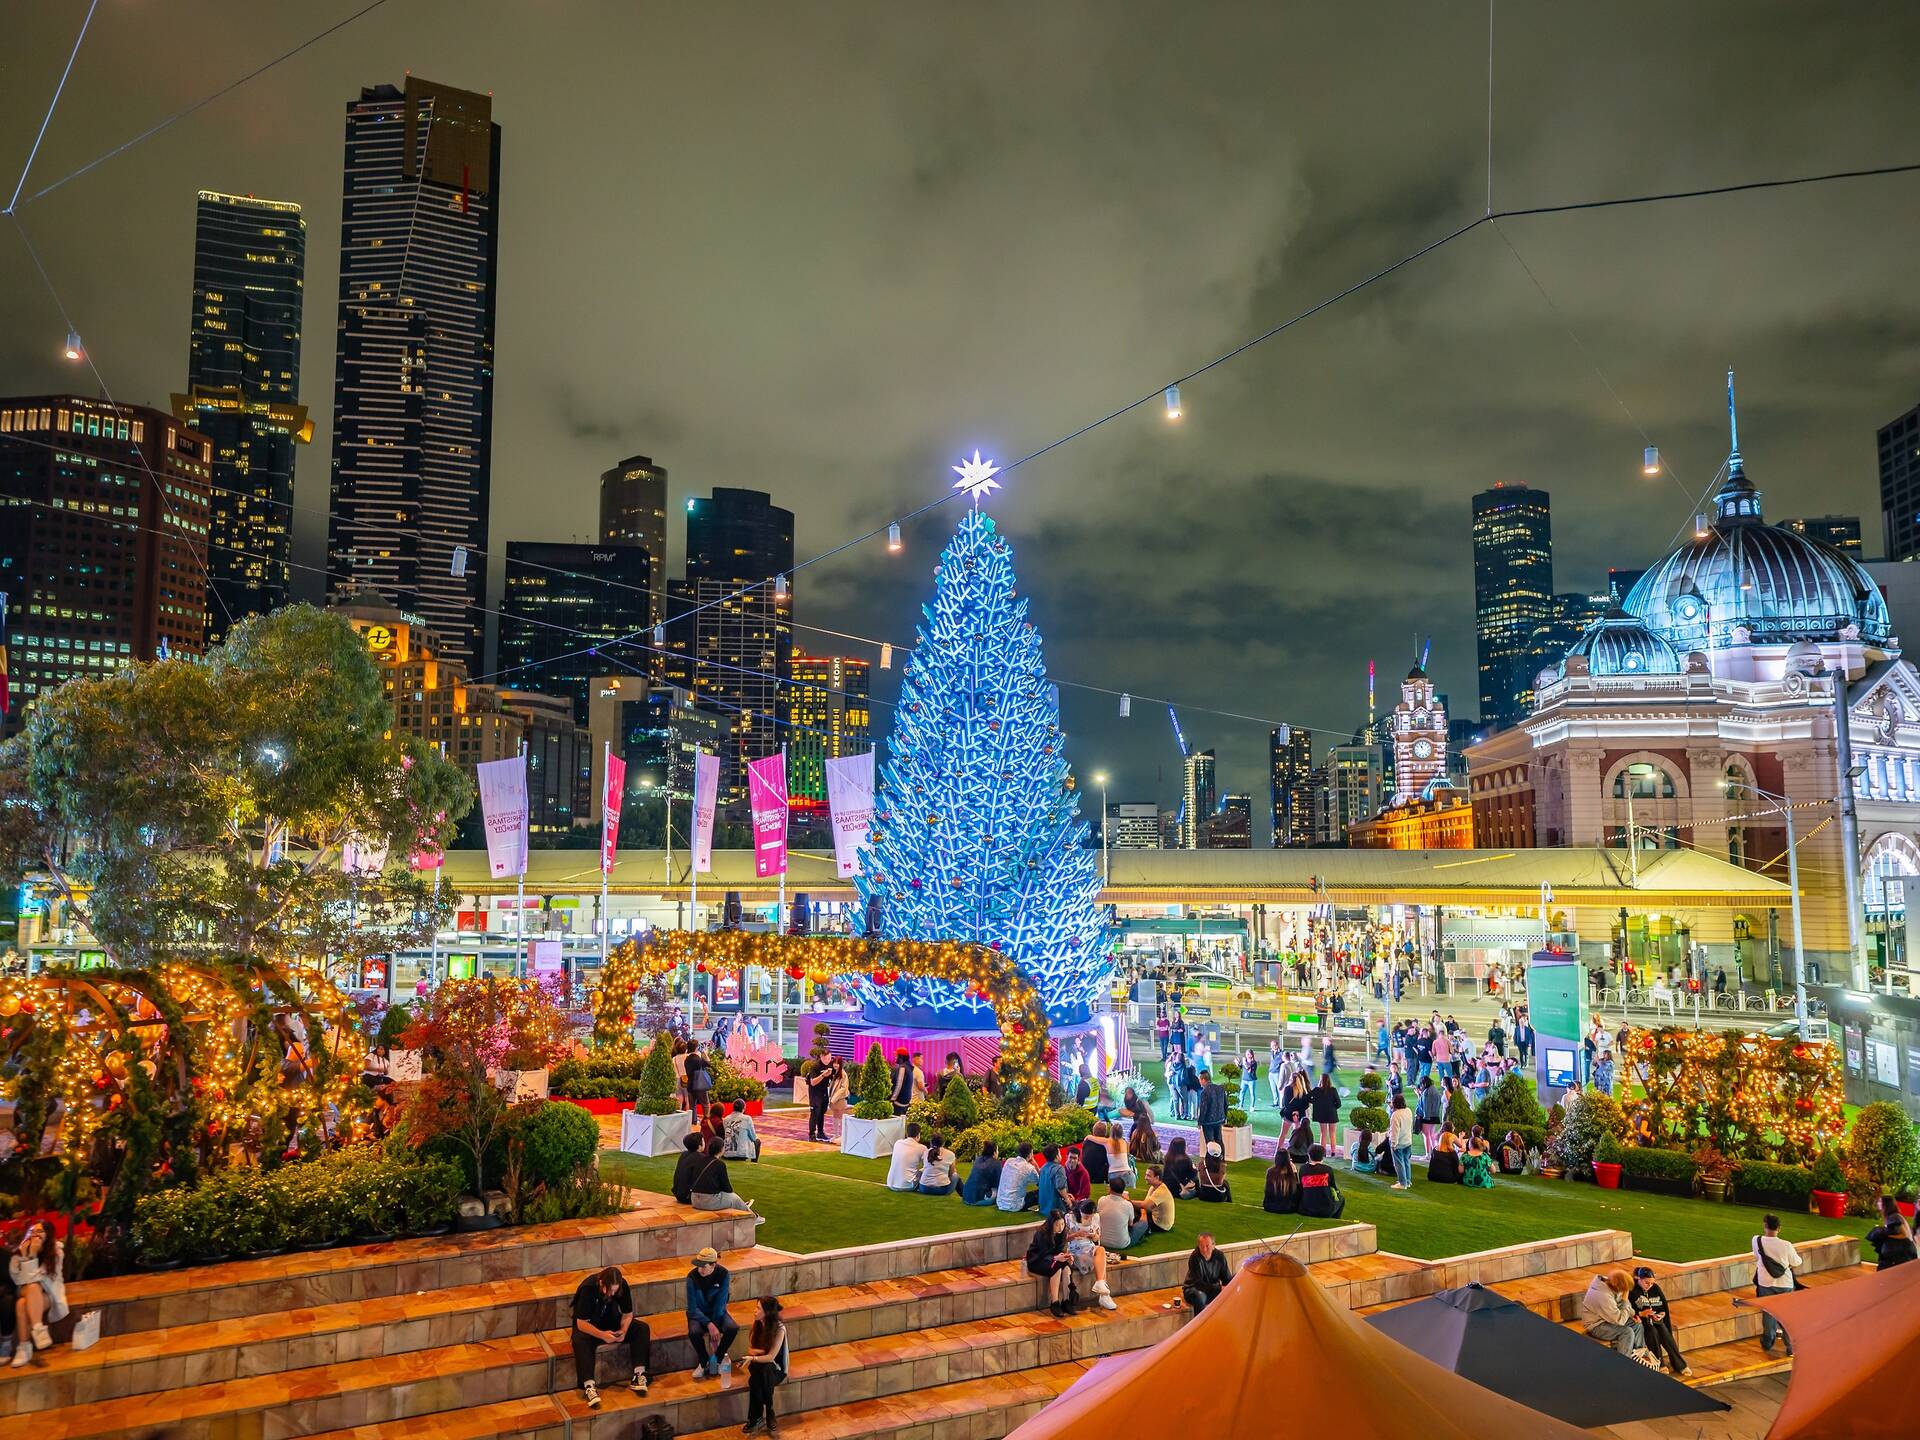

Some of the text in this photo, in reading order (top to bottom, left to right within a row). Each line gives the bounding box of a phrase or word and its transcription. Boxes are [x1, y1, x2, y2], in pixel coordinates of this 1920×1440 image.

[179, 438, 193, 450] IBM
[400, 610, 426, 627] Langham
[600, 689, 617, 697] pwc
